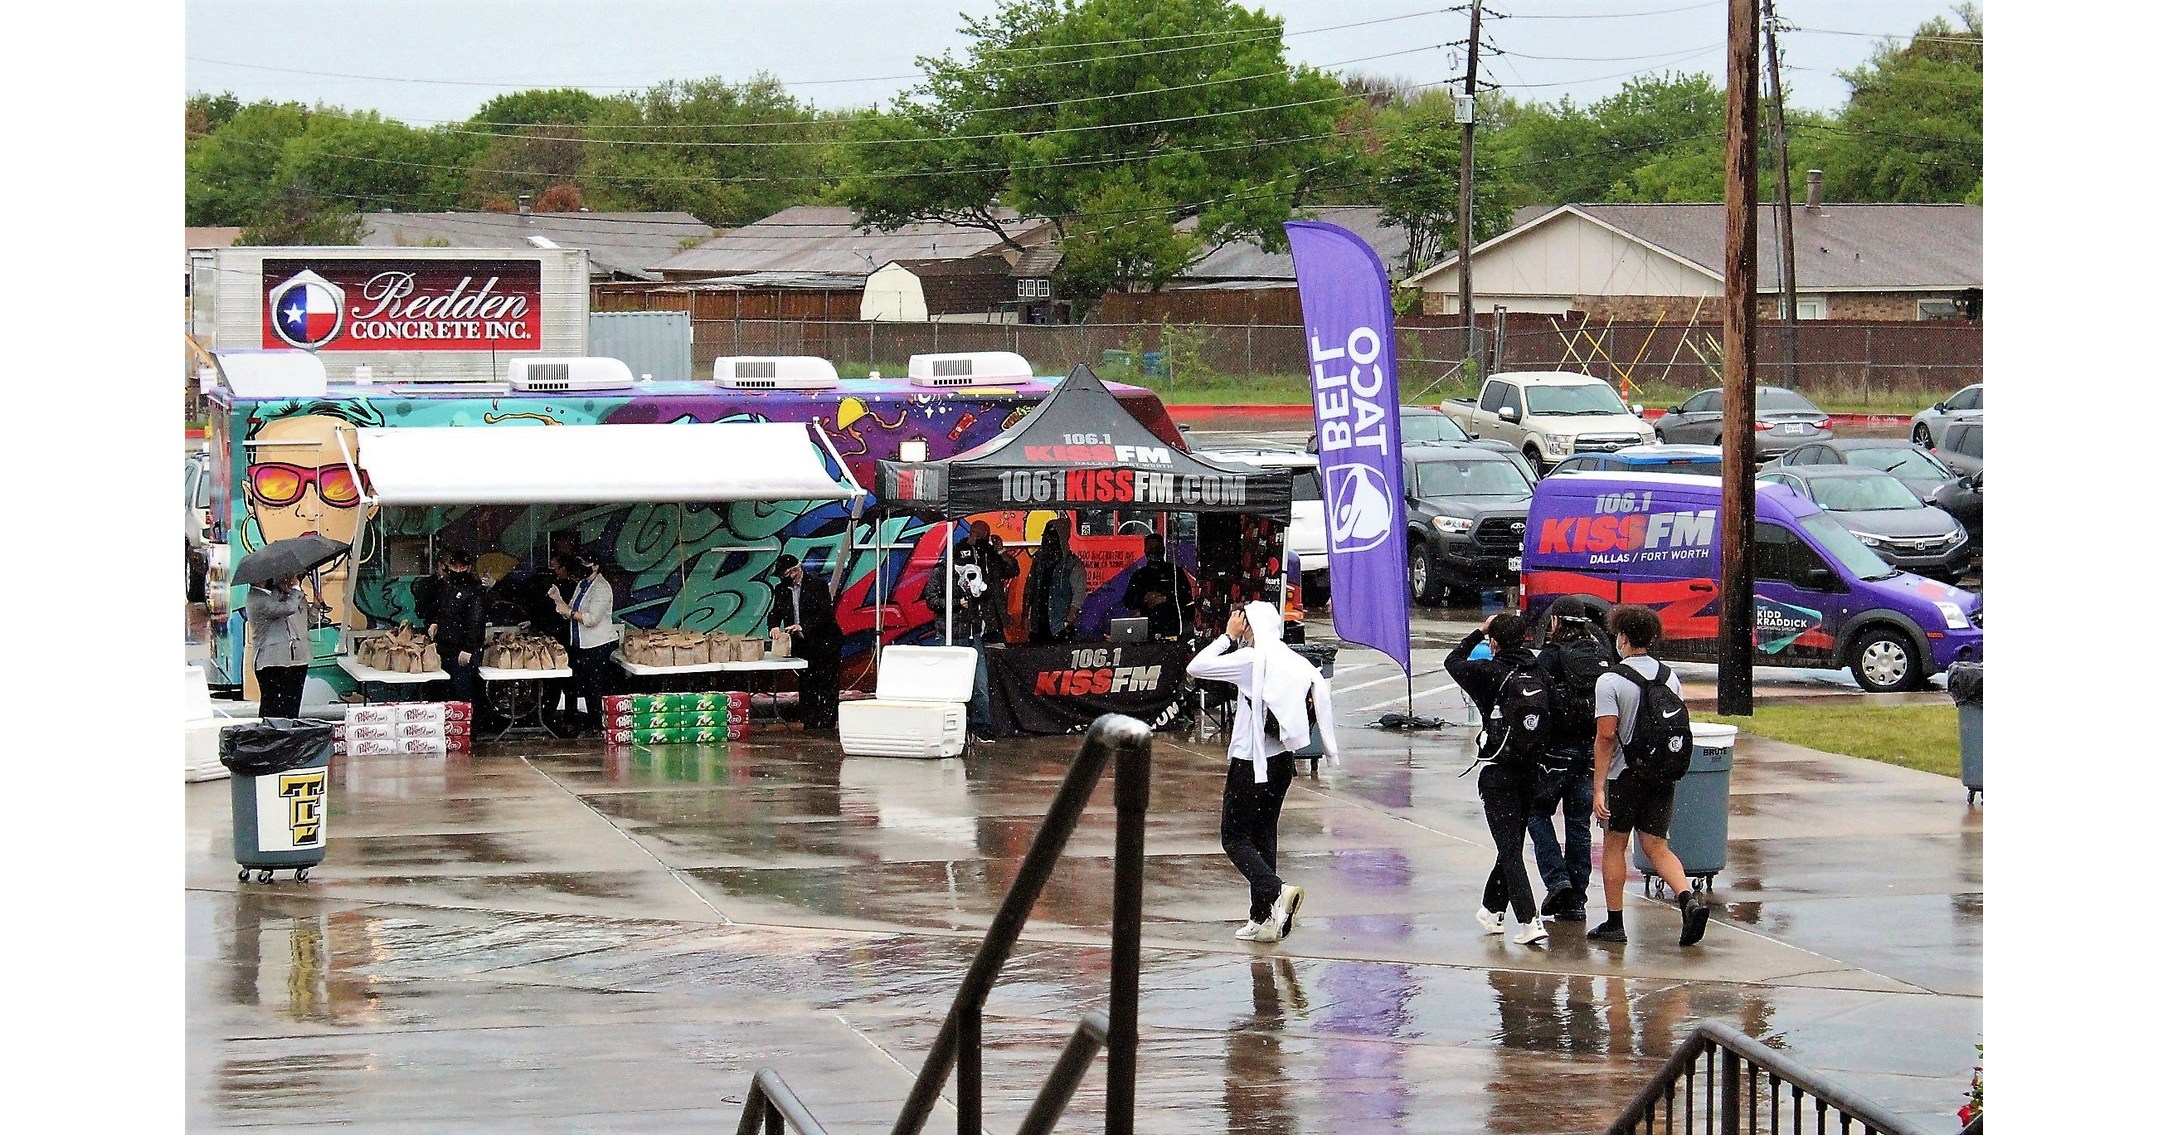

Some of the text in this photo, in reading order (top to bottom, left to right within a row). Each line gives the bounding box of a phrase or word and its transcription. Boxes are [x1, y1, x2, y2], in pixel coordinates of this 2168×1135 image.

[351, 271, 530, 320] Redden
[350, 321, 532, 340] CONCRETE INC.
[1311, 336, 1352, 452] BELL
[1347, 326, 1388, 456] TACO
[1063, 433, 1112, 445] 106.1
[998, 469, 1248, 506] 1061KISSFM.COM
[1595, 491, 1653, 514] 106.1
[1589, 553, 1630, 564] DALLAS
[1640, 551, 1669, 562] FORT
[1671, 549, 1710, 560] WORTH
[1756, 610, 1782, 619] KIDD
[1756, 617, 1808, 628] KRADDICK
[1070, 647, 1122, 669] 106.1
[1034, 664, 1163, 697] KISSFM
[1703, 748, 1728, 757] BRUTE
